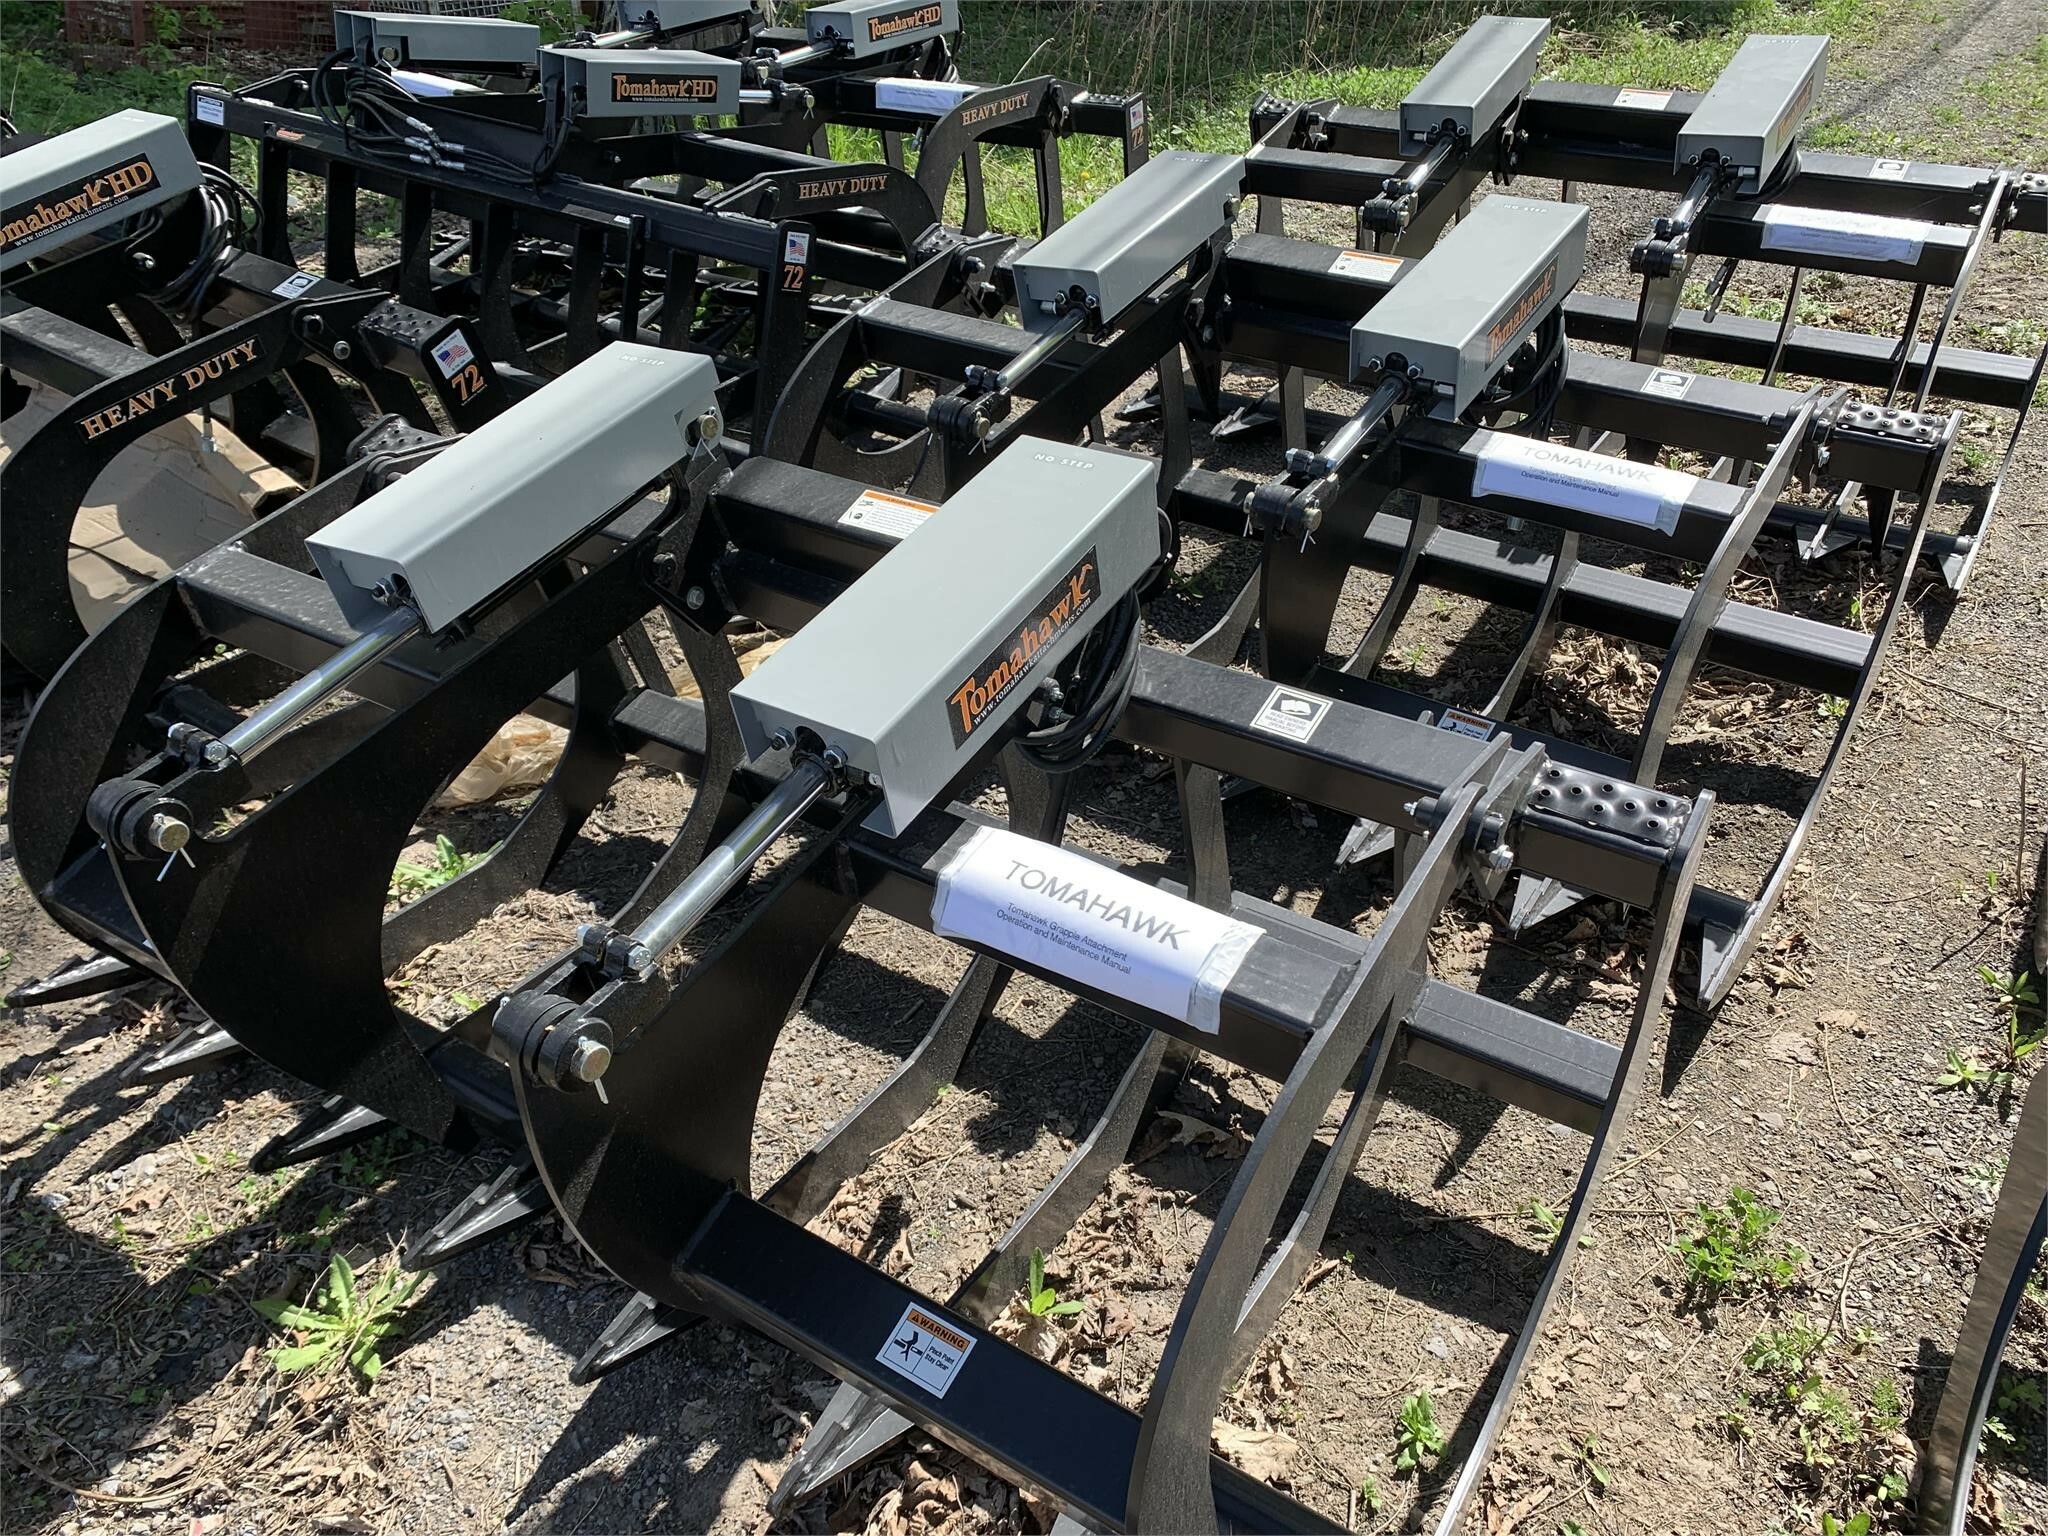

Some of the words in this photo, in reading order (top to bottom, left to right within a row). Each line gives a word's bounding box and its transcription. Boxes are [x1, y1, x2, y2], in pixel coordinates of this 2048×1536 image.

[869, 10, 923, 40] Tomahawk
[923, 6, 941, 24] HD
[613, 75, 692, 100] Tomahawk
[692, 80, 717, 97] HD
[962, 104, 997, 126] HEAVY
[1000, 93, 1029, 114] DUTY
[1132, 126, 1144, 148] 72
[104, 161, 153, 198] HD
[799, 180, 847, 199] HEAVY
[850, 176, 888, 193] DUTY
[14, 195, 129, 248] www.tomahawkattachments.com
[1503, 203, 1519, 211] NO
[784, 265, 804, 289] 72
[621, 353, 637, 363] NO
[640, 358, 665, 366] STEP
[81, 378, 177, 439] HEAVY
[182, 339, 258, 390] DUTY
[452, 364, 484, 401] 72
[1034, 453, 1055, 463] NO
[1060, 457, 1094, 470] STEP
[1523, 446, 1656, 482] TOMAHAWK
[1521, 470, 1548, 484] Operation
[1549, 477, 1560, 486] and
[1561, 480, 1597, 493] Maintenance
[1598, 486, 1620, 498] Manual
[951, 563, 1093, 734] Tomahawk
[974, 597, 1091, 726] www.tomahawkattachments.com
[1006, 860, 1191, 950] TOMAHAWK
[997, 909, 1033, 932] Operation
[1034, 926, 1049, 939] and
[1050, 932, 1100, 961] Maintenance
[1101, 955, 1132, 975] Manual
[1008, 902, 1048, 927] Tomahawk
[1049, 921, 1081, 941] Grapple
[1081, 936, 1127, 961] Attachment
[920, 1317, 966, 1349] WARNING
[924, 1354, 936, 1365] Stay
[936, 1360, 949, 1371] Clear
[929, 1345, 942, 1358] Pinch
[941, 1353, 955, 1366] Point
